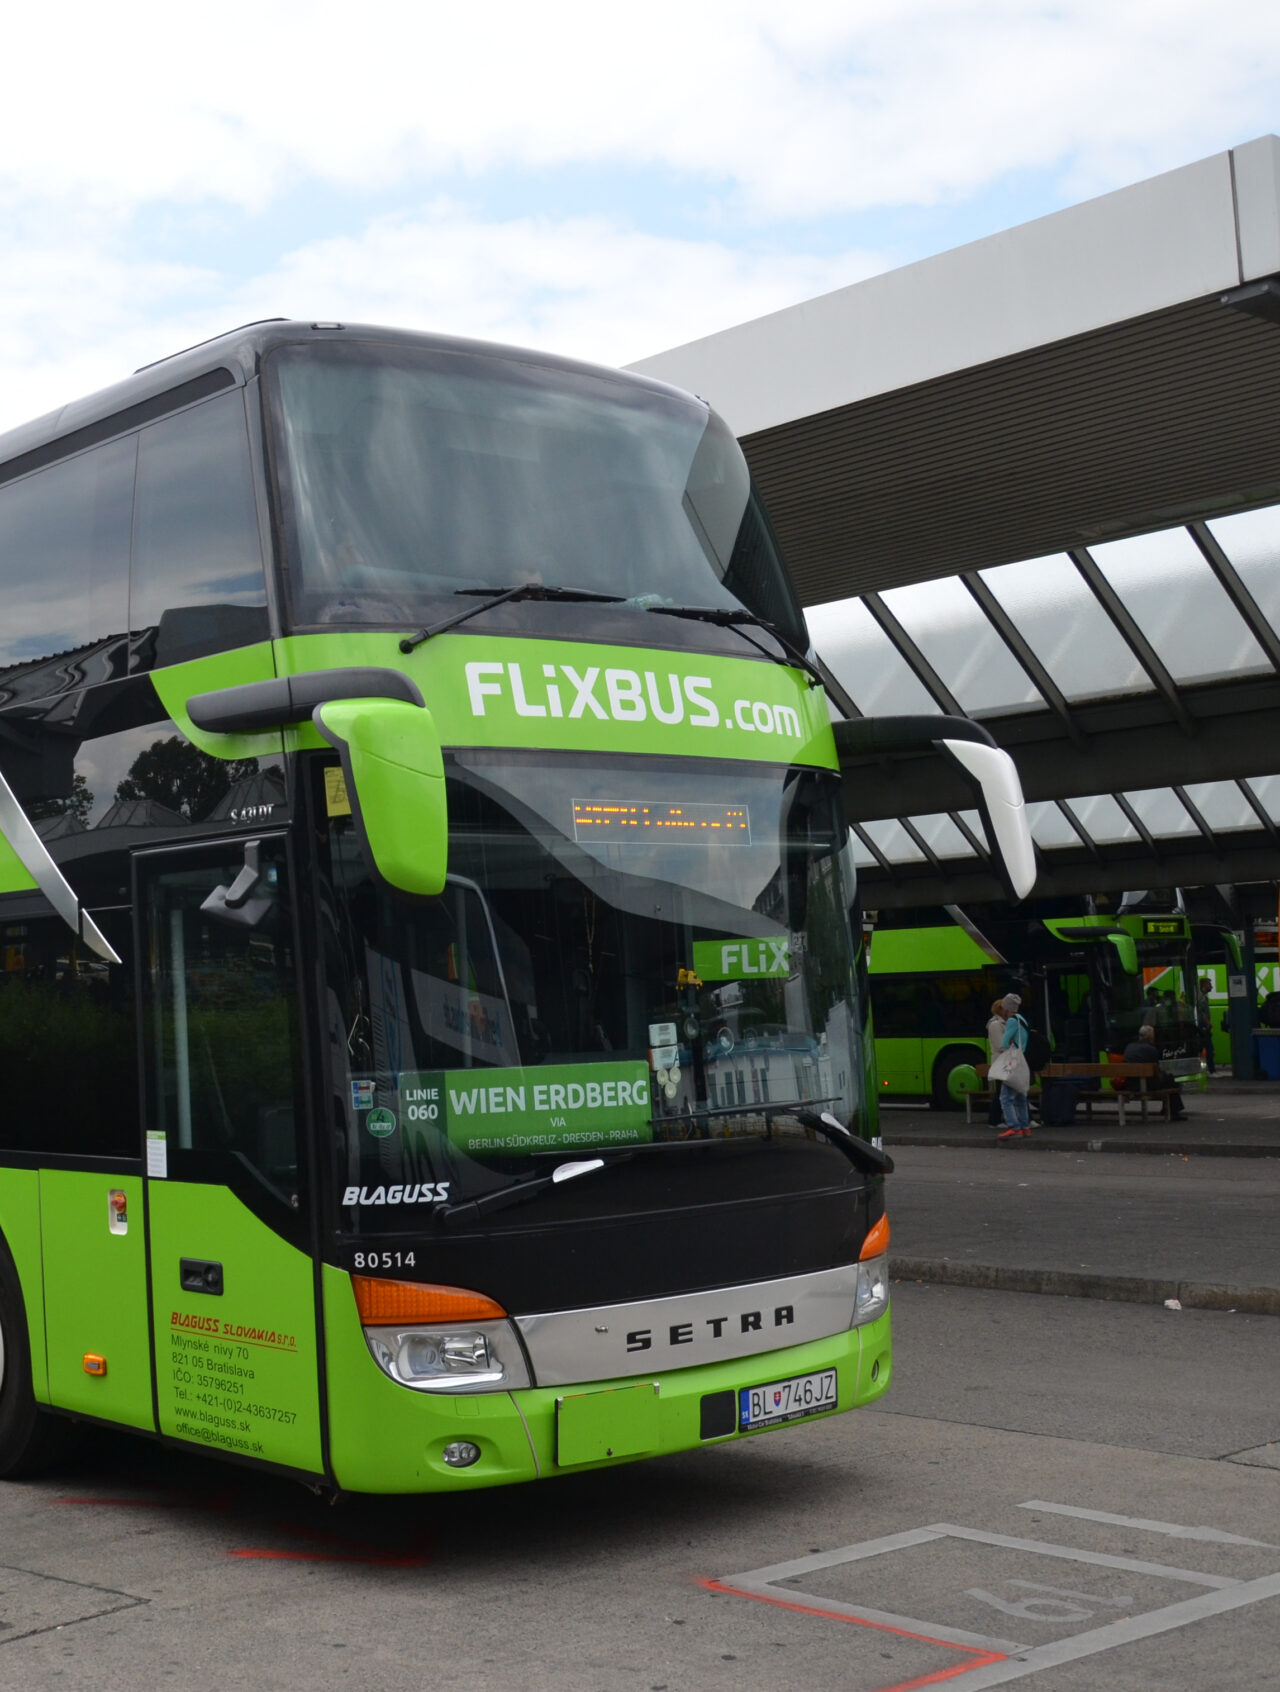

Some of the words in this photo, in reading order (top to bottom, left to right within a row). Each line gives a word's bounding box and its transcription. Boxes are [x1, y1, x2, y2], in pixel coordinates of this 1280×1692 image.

[405, 1088, 439, 1101] LINIE
[449, 1086, 525, 1116] WIEN
[533, 1080, 648, 1111] ERDBERG
[407, 1104, 438, 1121] 060
[550, 1117, 566, 1128] VIA
[468, 1135, 505, 1150] BERLIN
[506, 1133, 557, 1148] SÜDKREUZ
[563, 1130, 604, 1144] DRESDEN
[609, 1129, 639, 1140] PRAHA
[342, 1181, 450, 1206] BLAGUSS
[354, 1252, 416, 1268] 80514
[170, 1312, 220, 1332] BLAGUSS
[223, 1323, 276, 1342] SLOVAKIA
[626, 1305, 794, 1353] SETRA
[171, 1334, 209, 1352] Mlynské
[213, 1344, 234, 1359] nivy
[236, 1346, 249, 1360] 70
[172, 1352, 188, 1365] 821
[191, 1356, 204, 1368] 05
[206, 1358, 255, 1379] Bratislava
[197, 1374, 244, 1395] 35796251
[752, 1390, 773, 1418] BL
[782, 1374, 834, 1411] 746JZ
[174, 1406, 251, 1433] www.blaguss.sk
[176, 1422, 265, 1454] office@blaguss.sk
